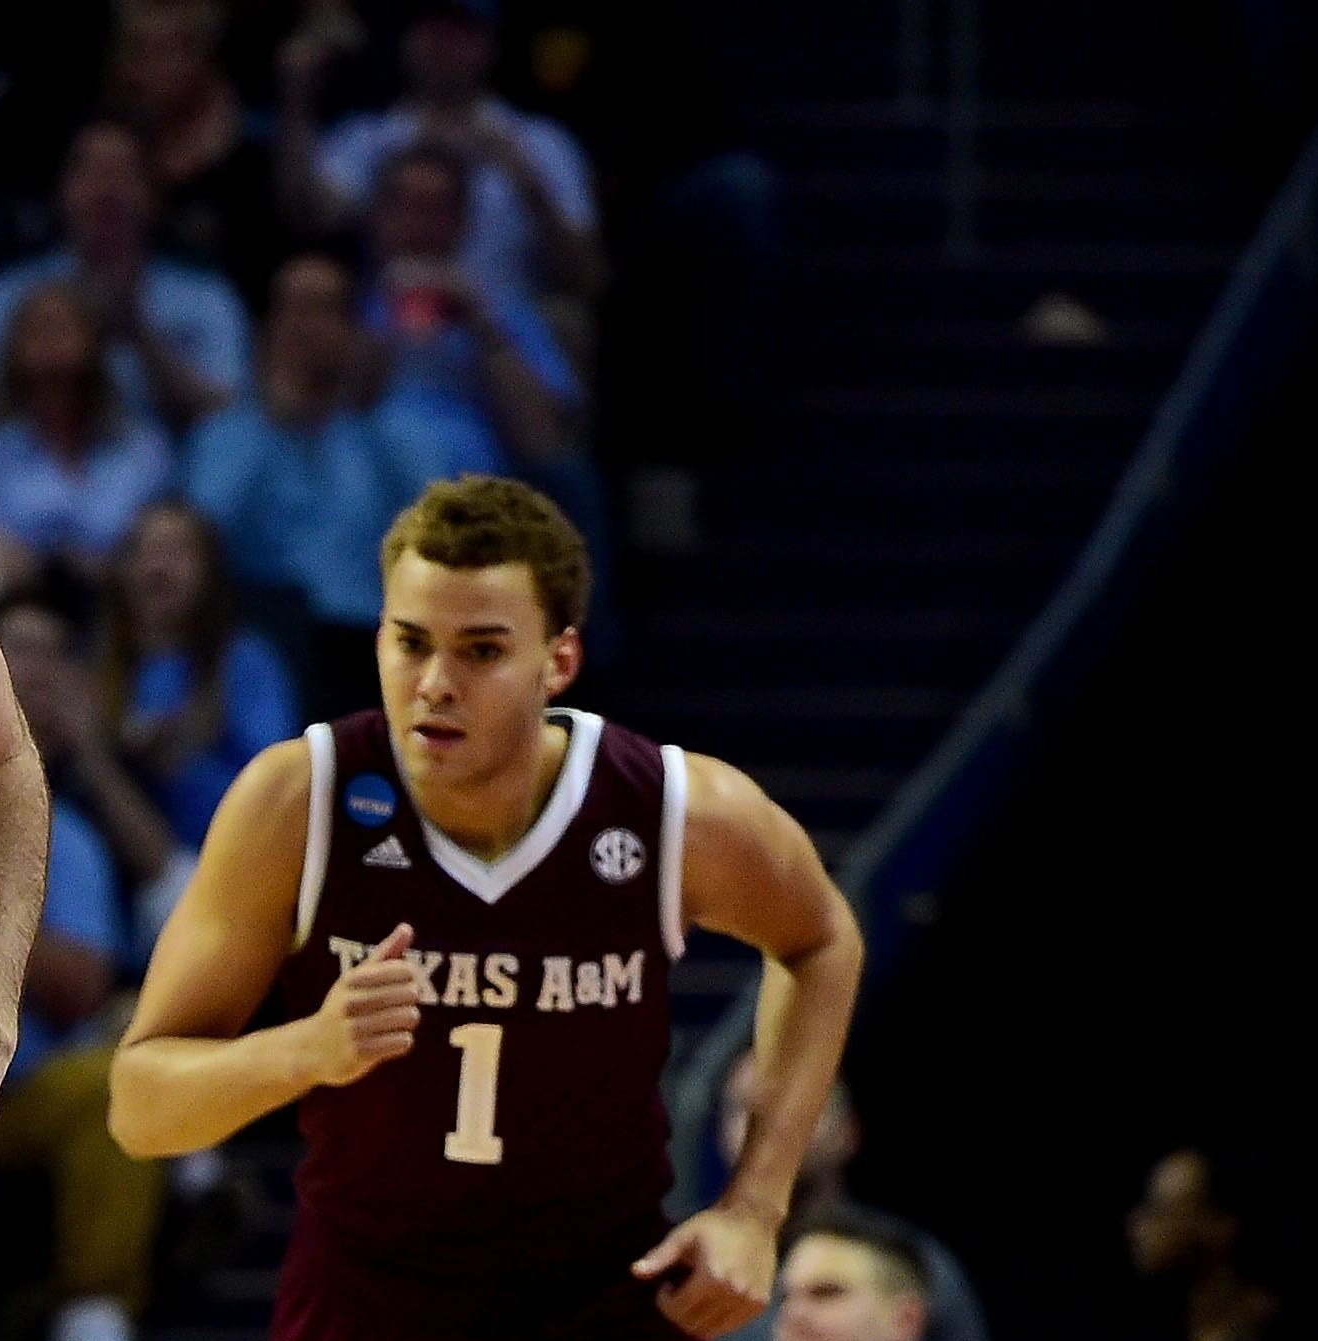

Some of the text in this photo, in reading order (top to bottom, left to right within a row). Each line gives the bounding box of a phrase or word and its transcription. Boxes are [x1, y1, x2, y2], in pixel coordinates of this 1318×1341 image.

[329, 936, 645, 1012] TXAS A&M
[444, 1023, 503, 1165] 1
